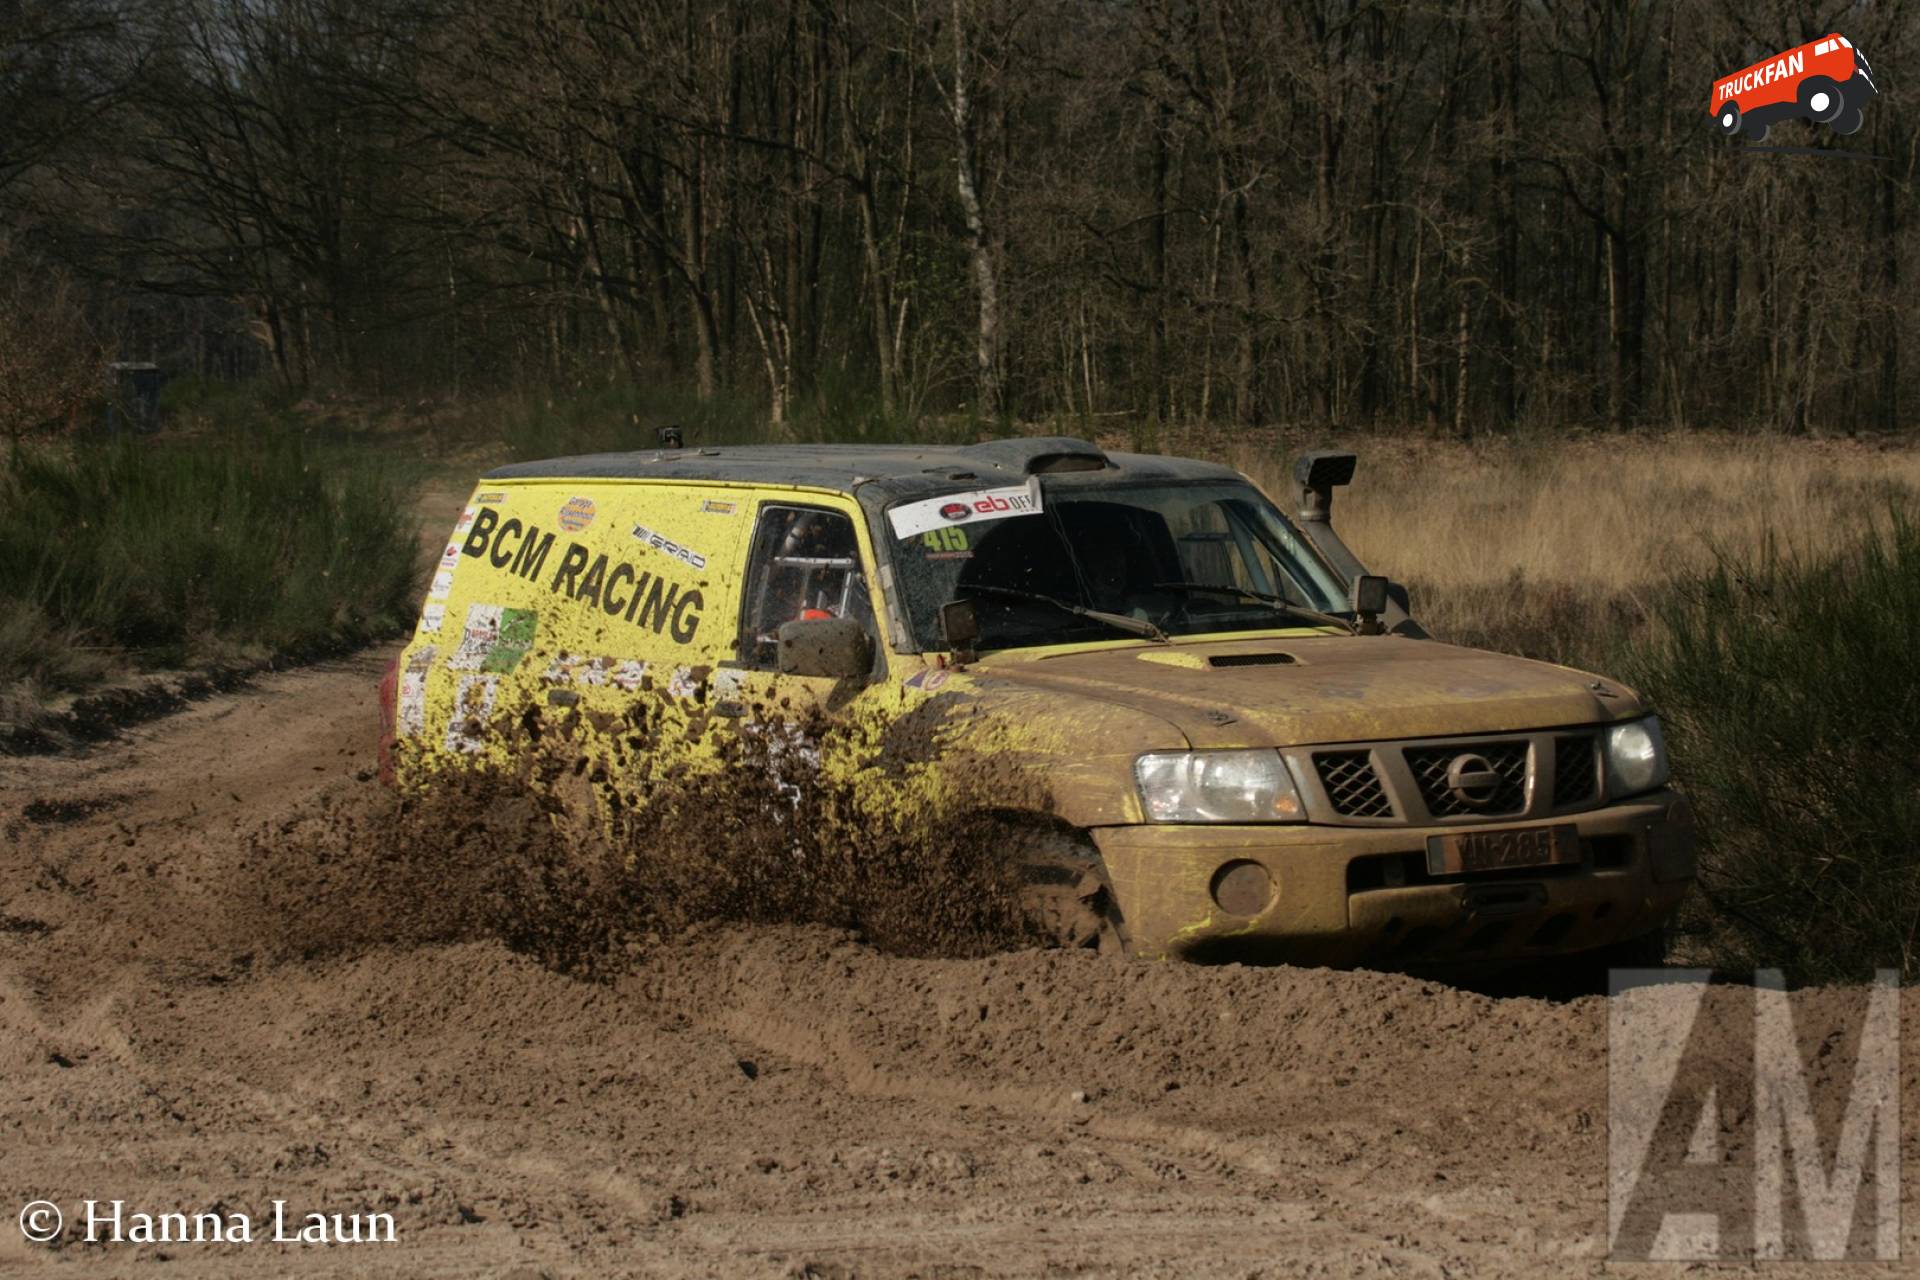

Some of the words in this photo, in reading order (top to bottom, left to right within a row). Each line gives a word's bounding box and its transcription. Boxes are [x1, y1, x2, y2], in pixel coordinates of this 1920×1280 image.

[462, 507, 557, 583] BCM
[551, 543, 705, 645] RACING
[923, 526, 969, 551] 415
